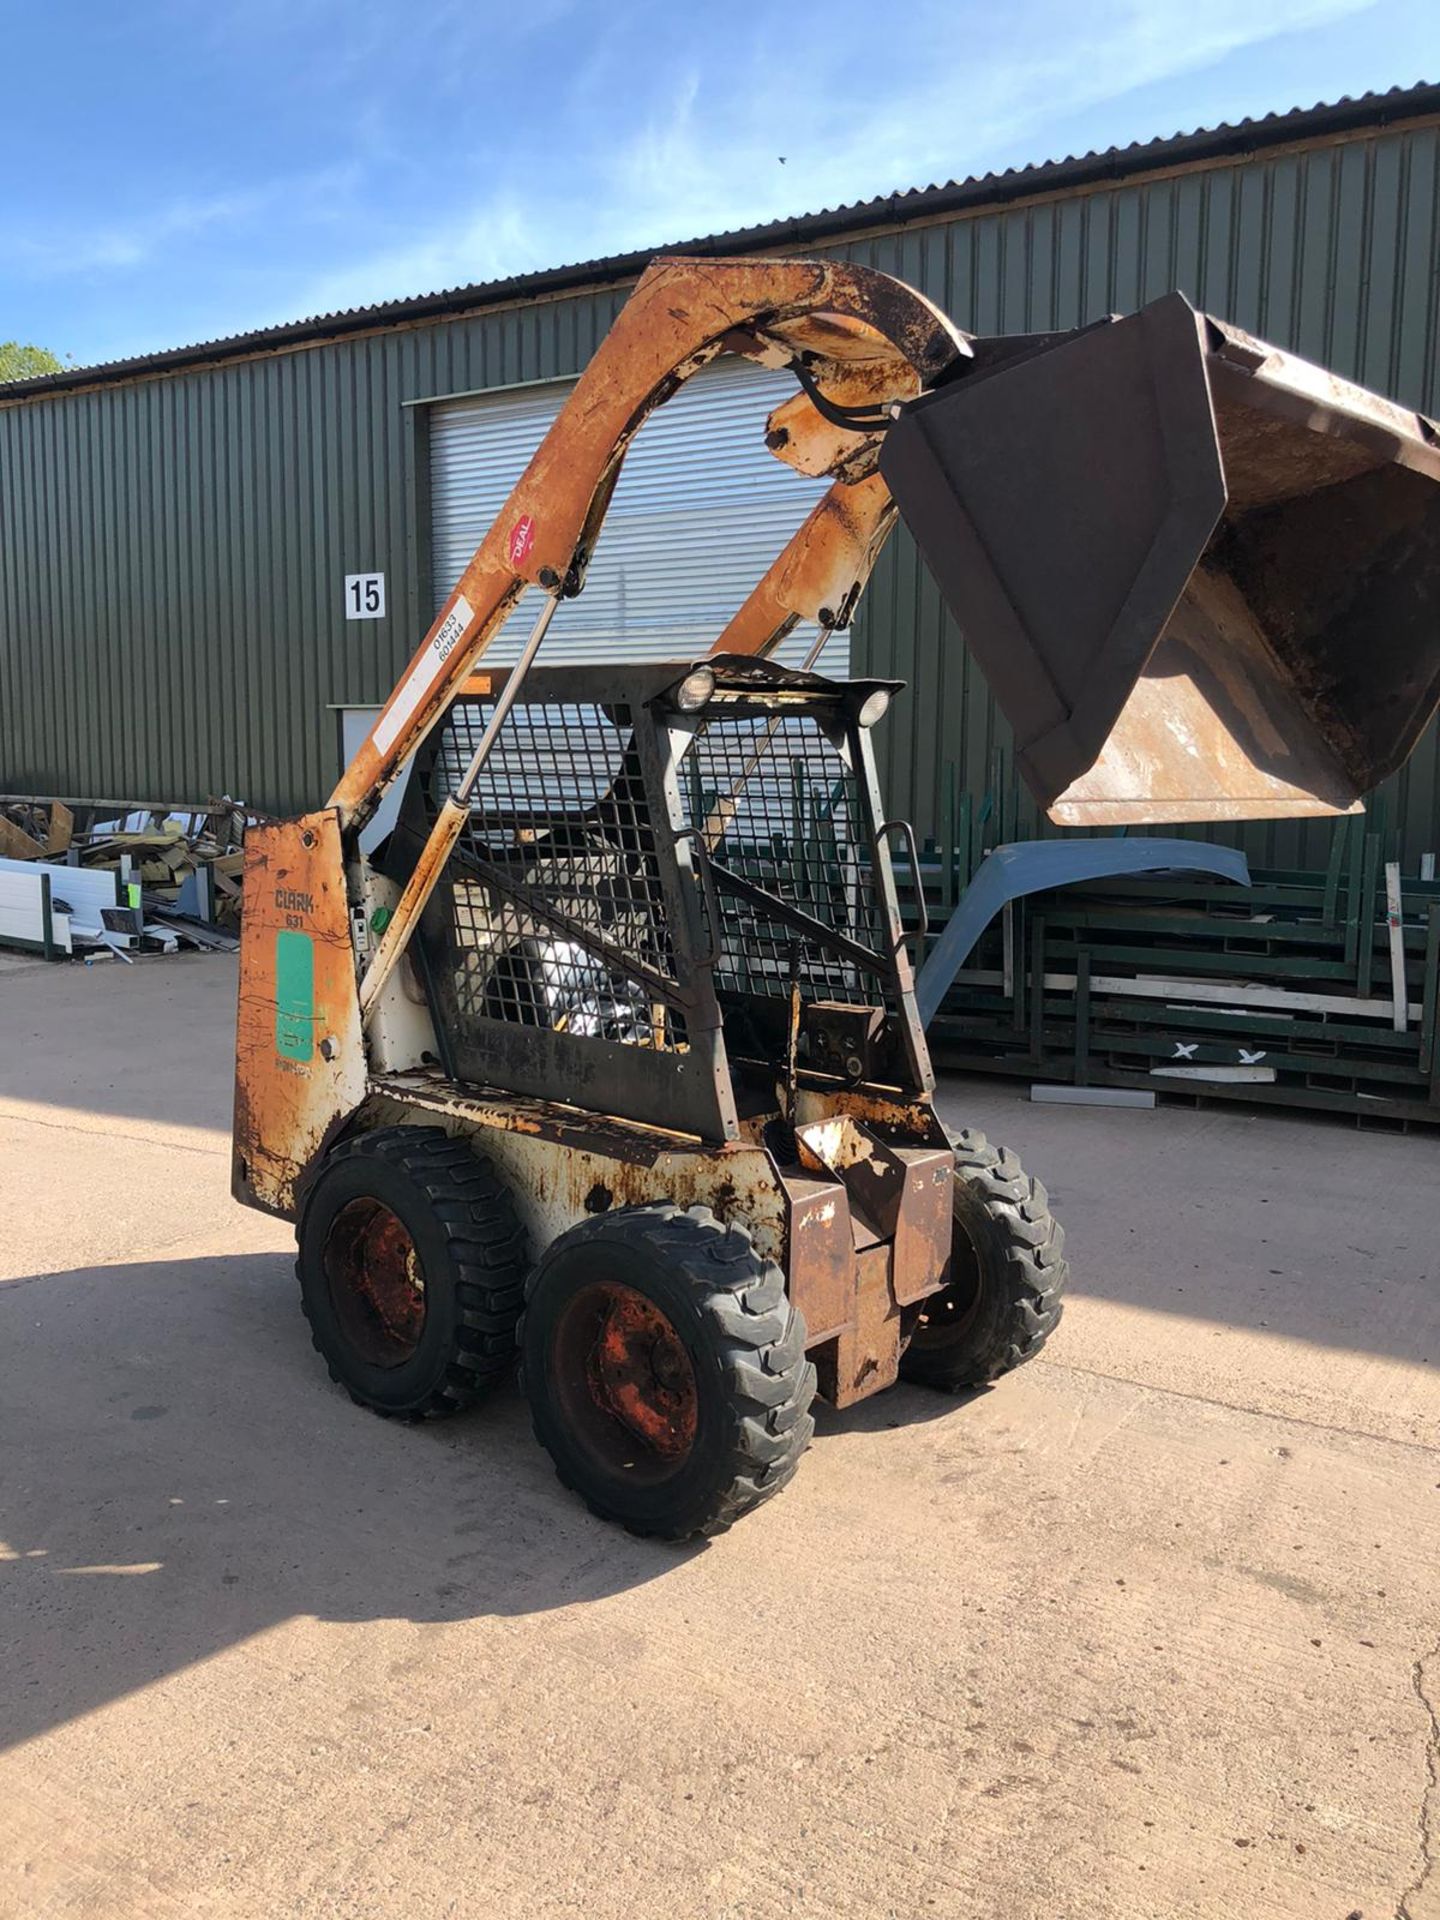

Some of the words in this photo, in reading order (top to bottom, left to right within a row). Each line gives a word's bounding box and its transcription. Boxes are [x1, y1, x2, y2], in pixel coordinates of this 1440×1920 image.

[513, 523, 528, 558] DEAL
[351, 580, 380, 611] 15
[433, 613, 457, 649] 01633
[439, 623, 464, 662] 601444
[275, 889, 313, 914] CLARK
[286, 913, 303, 928] 631
